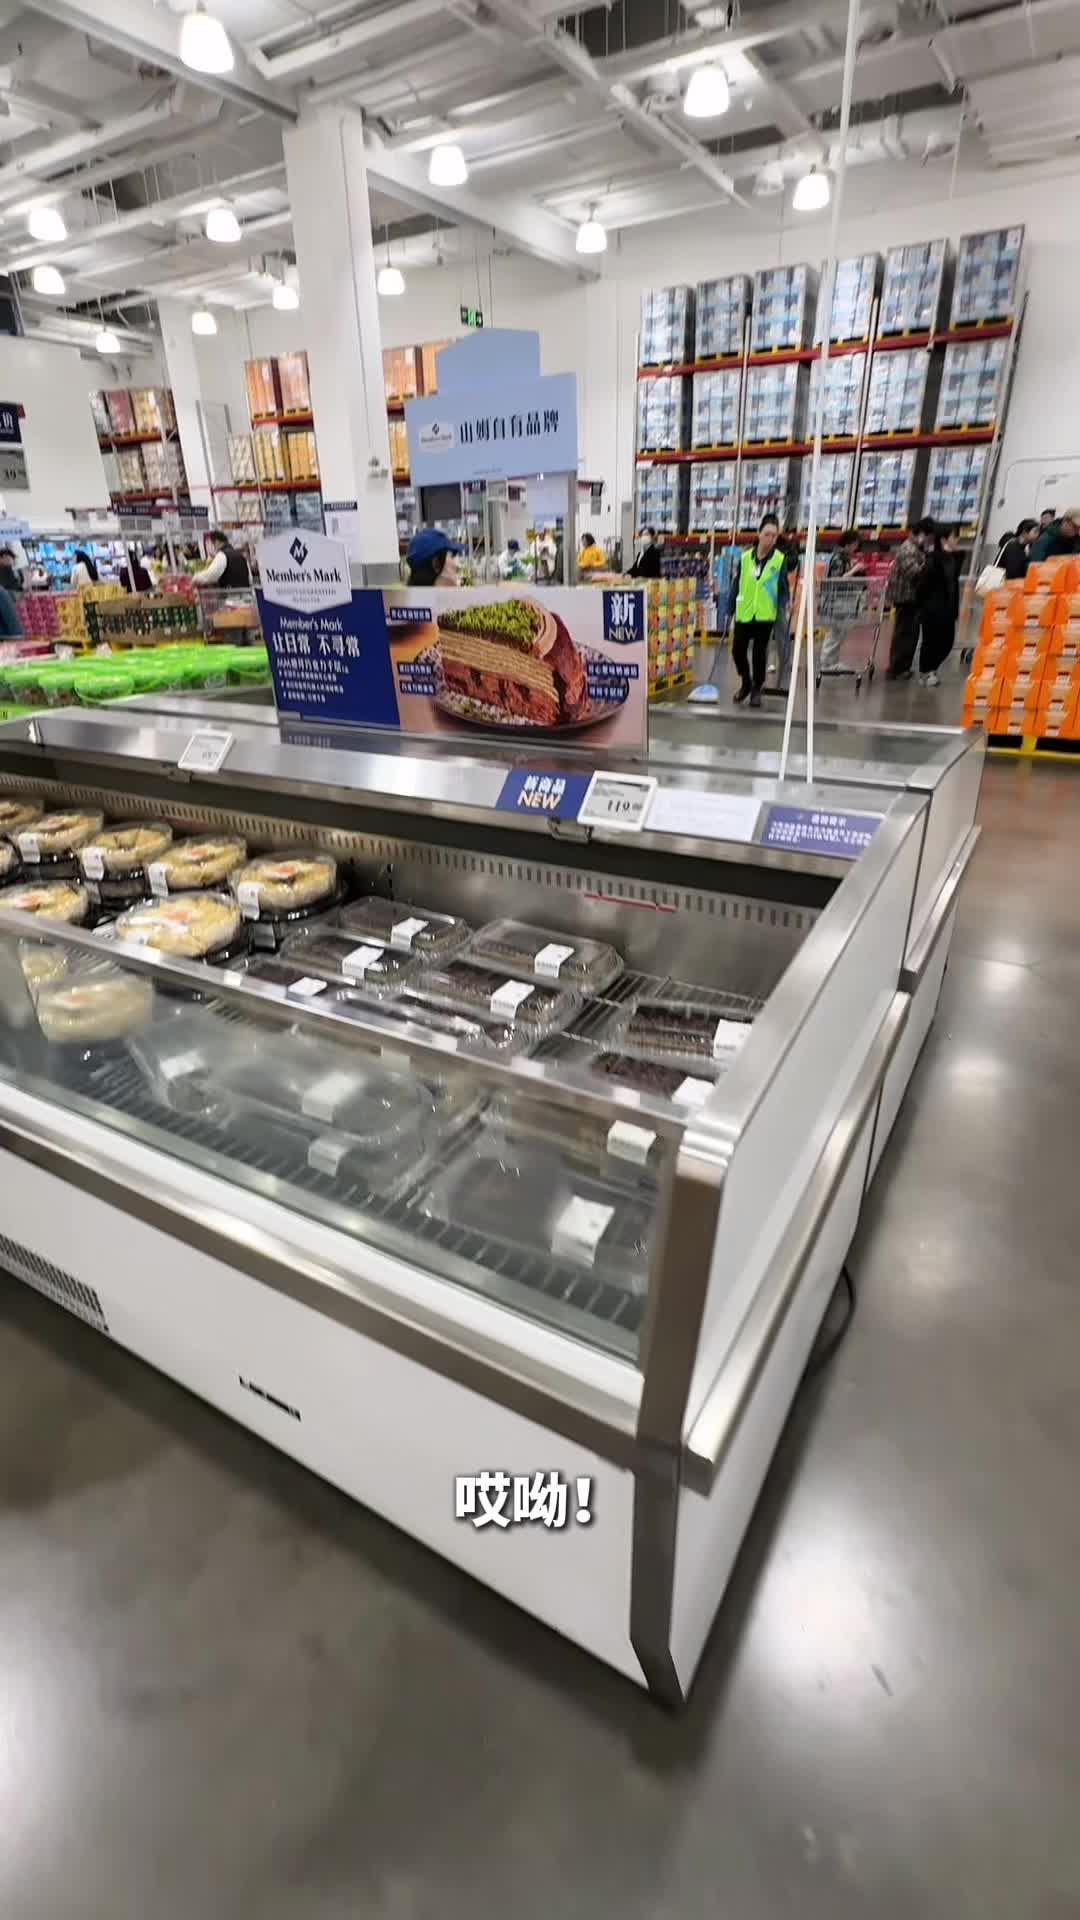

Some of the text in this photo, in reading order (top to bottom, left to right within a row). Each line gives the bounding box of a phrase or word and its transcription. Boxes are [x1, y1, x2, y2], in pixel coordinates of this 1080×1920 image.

[266, 567, 342, 583] Member's Mark
[610, 592, 636, 627] 新
[280, 616, 343, 632] Member's Mark
[608, 626, 638, 641] NEW
[272, 631, 360, 658] 让日常 不寻常
[516, 789, 561, 811] NEW
